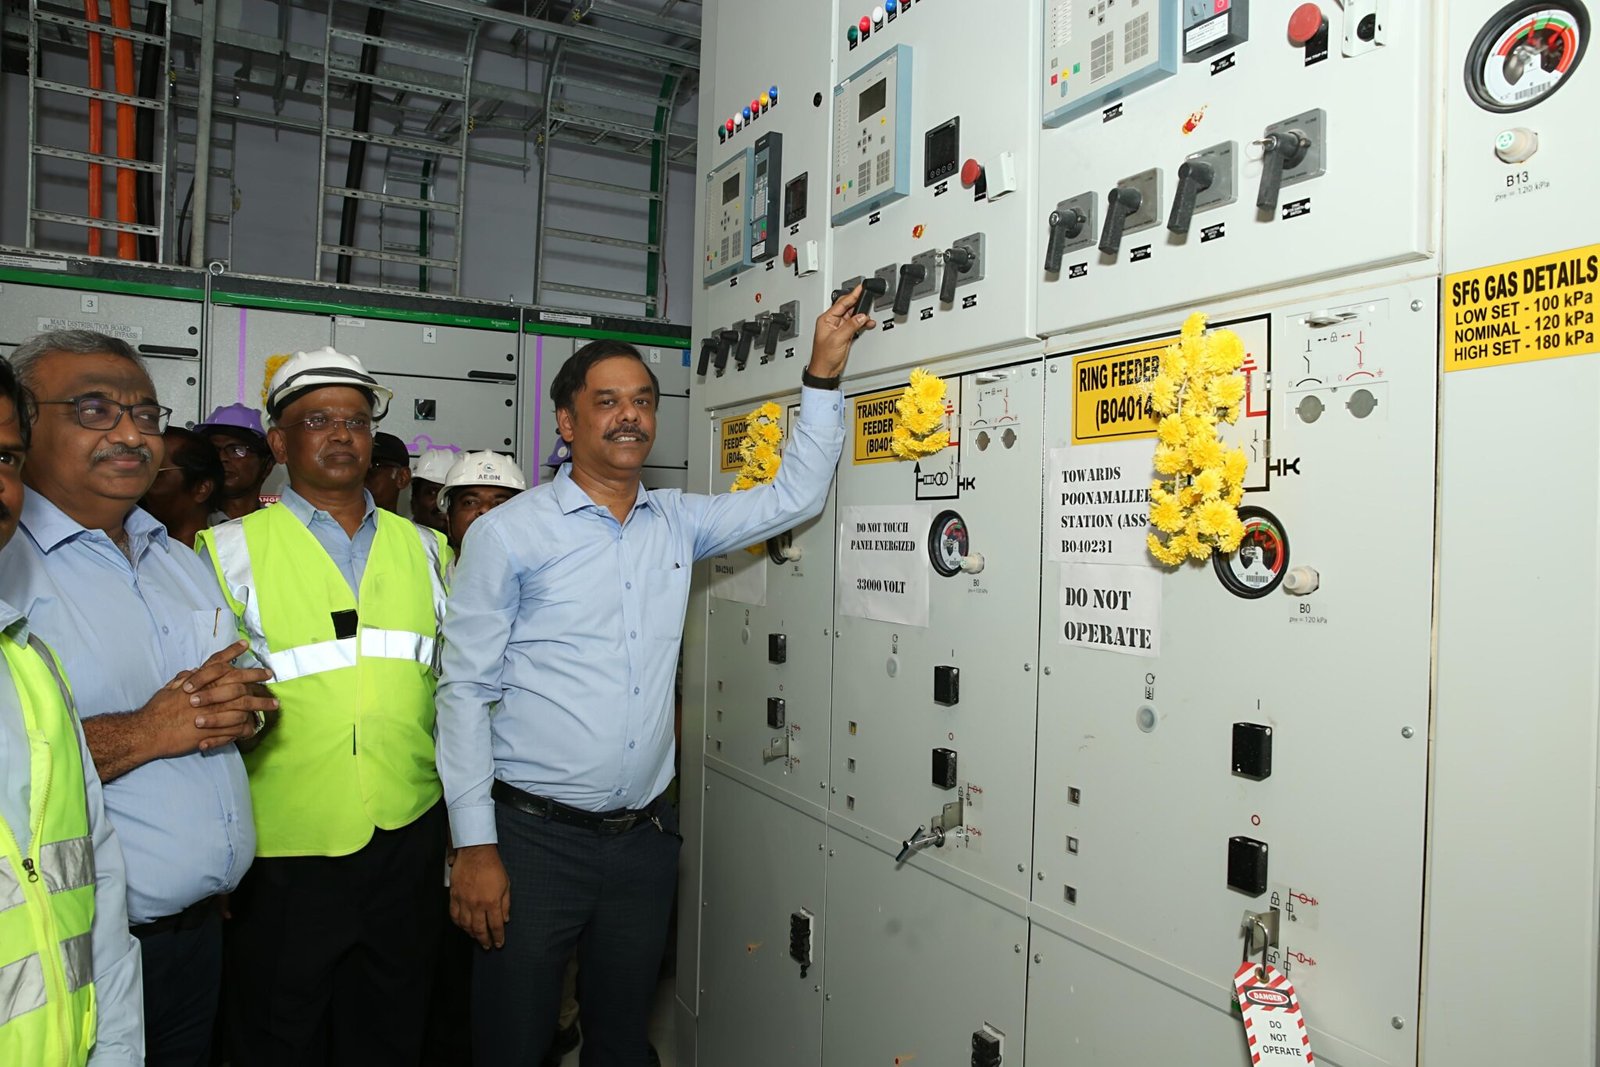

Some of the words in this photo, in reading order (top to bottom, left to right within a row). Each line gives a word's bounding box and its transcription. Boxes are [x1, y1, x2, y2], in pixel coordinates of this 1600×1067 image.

[1506, 171, 1528, 187] B13
[1518, 185, 1533, 195] 120
[1534, 180, 1550, 191] kPa
[1452, 278, 1480, 307] SF6
[1484, 271, 1518, 301] GAS
[1523, 255, 1598, 294] DETAILS
[1455, 307, 1487, 325] LOW
[1491, 301, 1520, 319] SET
[1533, 294, 1559, 312] 100
[1564, 290, 1593, 307] kPa
[67, 320, 109, 330] DISTRIBUTION
[1455, 321, 1520, 343] NOMINAL
[1534, 314, 1560, 331] 120
[1565, 310, 1594, 327] kPa
[1454, 343, 1488, 361] HIGH
[1492, 339, 1521, 356] SET
[1535, 333, 1560, 350] 180
[1565, 330, 1594, 346] kPa
[1080, 364, 1107, 392] RING
[1111, 355, 1160, 387] FEEDER
[1096, 393, 1153, 431] (B04014
[863, 418, 894, 436] FEEDER
[1062, 467, 1121, 483] TOWARDS
[1061, 488, 1153, 506] POONAMALLEE
[857, 523, 866, 533] DO
[867, 523, 881, 533] NOT
[883, 522, 909, 533] TOUCH
[1061, 514, 1113, 529] STATION
[851, 540, 873, 550] PANEL
[875, 540, 916, 551] ENERGIZED
[1061, 540, 1112, 553] B040231
[857, 579, 881, 591] 33000
[883, 580, 906, 593] VOLT
[1065, 587, 1088, 607] DO
[1093, 589, 1131, 610] NOT
[1299, 603, 1311, 613] B0
[1064, 621, 1151, 649] OPERATE
[1253, 992, 1283, 1002] DANGER
[1269, 1020, 1282, 1029] DO
[1270, 1033, 1287, 1042] NOT
[1262, 1045, 1302, 1057] OPERATE
